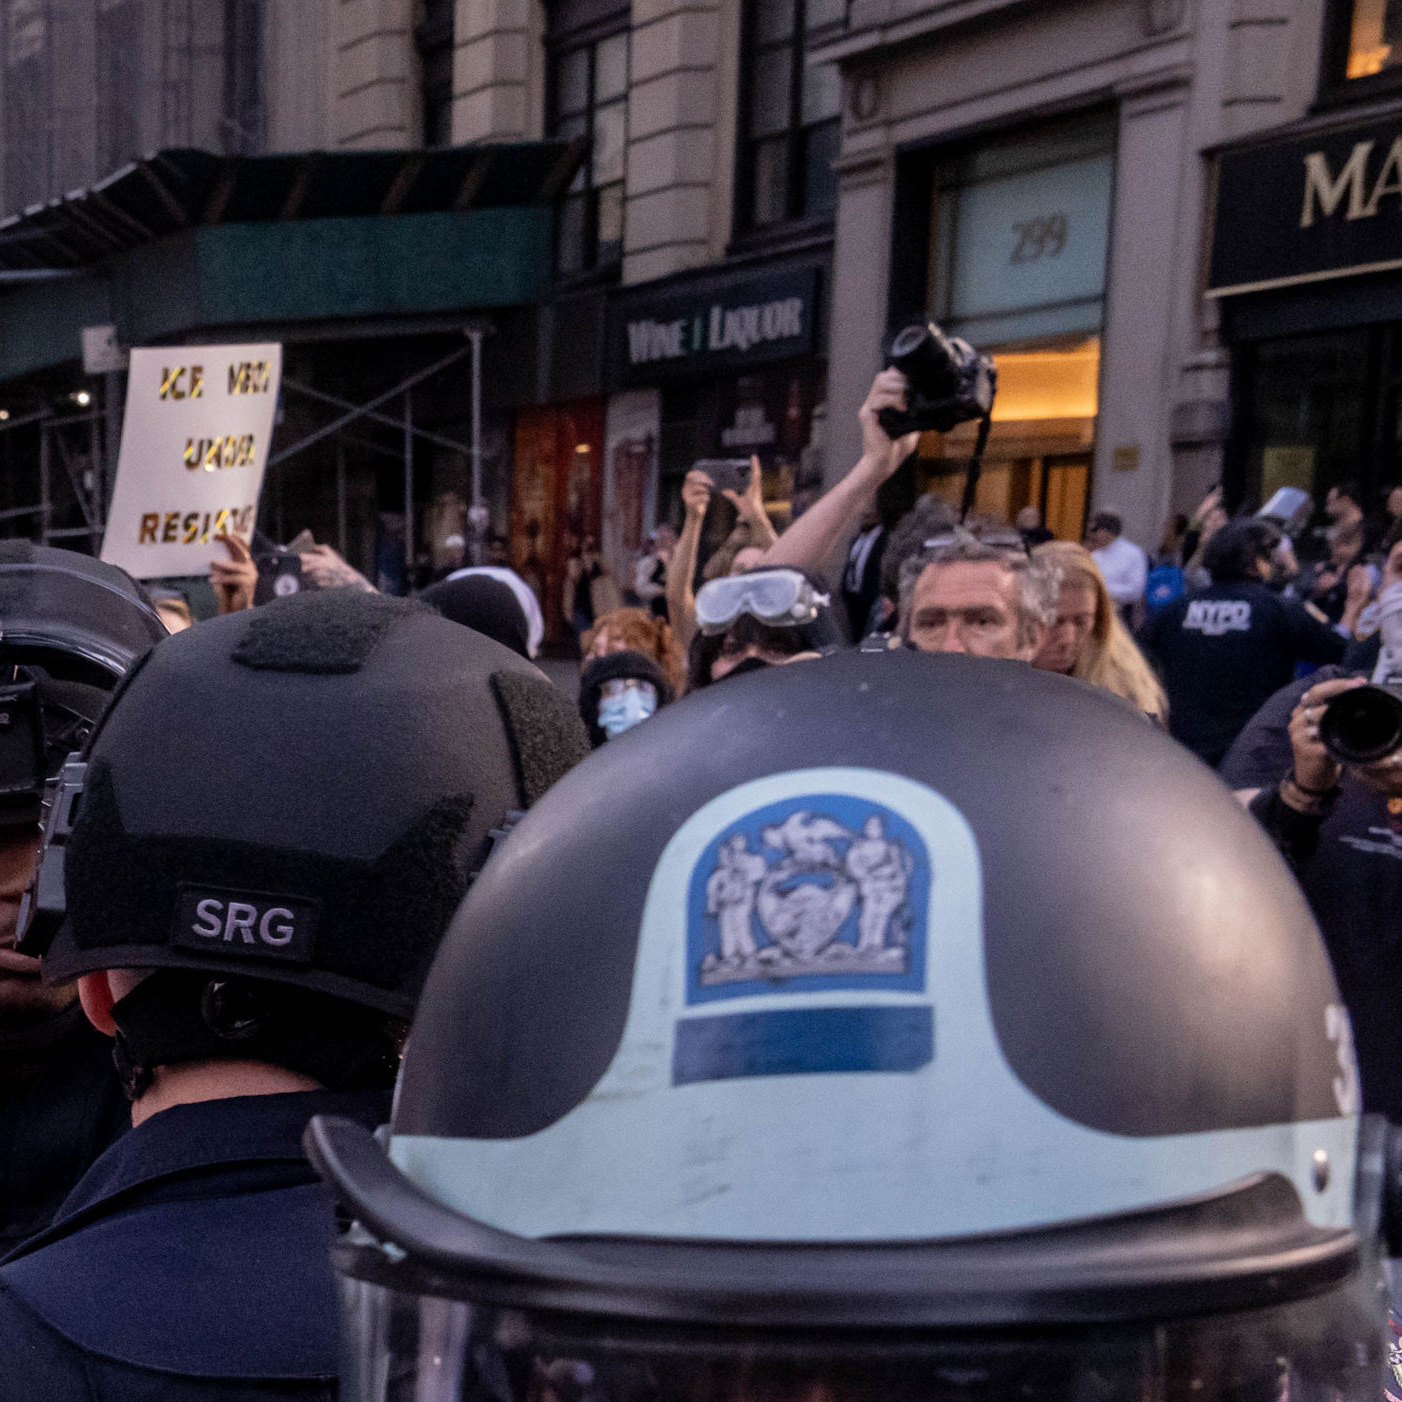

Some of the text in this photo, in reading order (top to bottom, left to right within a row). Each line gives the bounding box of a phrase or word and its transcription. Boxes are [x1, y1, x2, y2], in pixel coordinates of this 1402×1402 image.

[1009, 211, 1069, 266] 299
[159, 366, 204, 402] ICE
[191, 898, 295, 947] SRG
